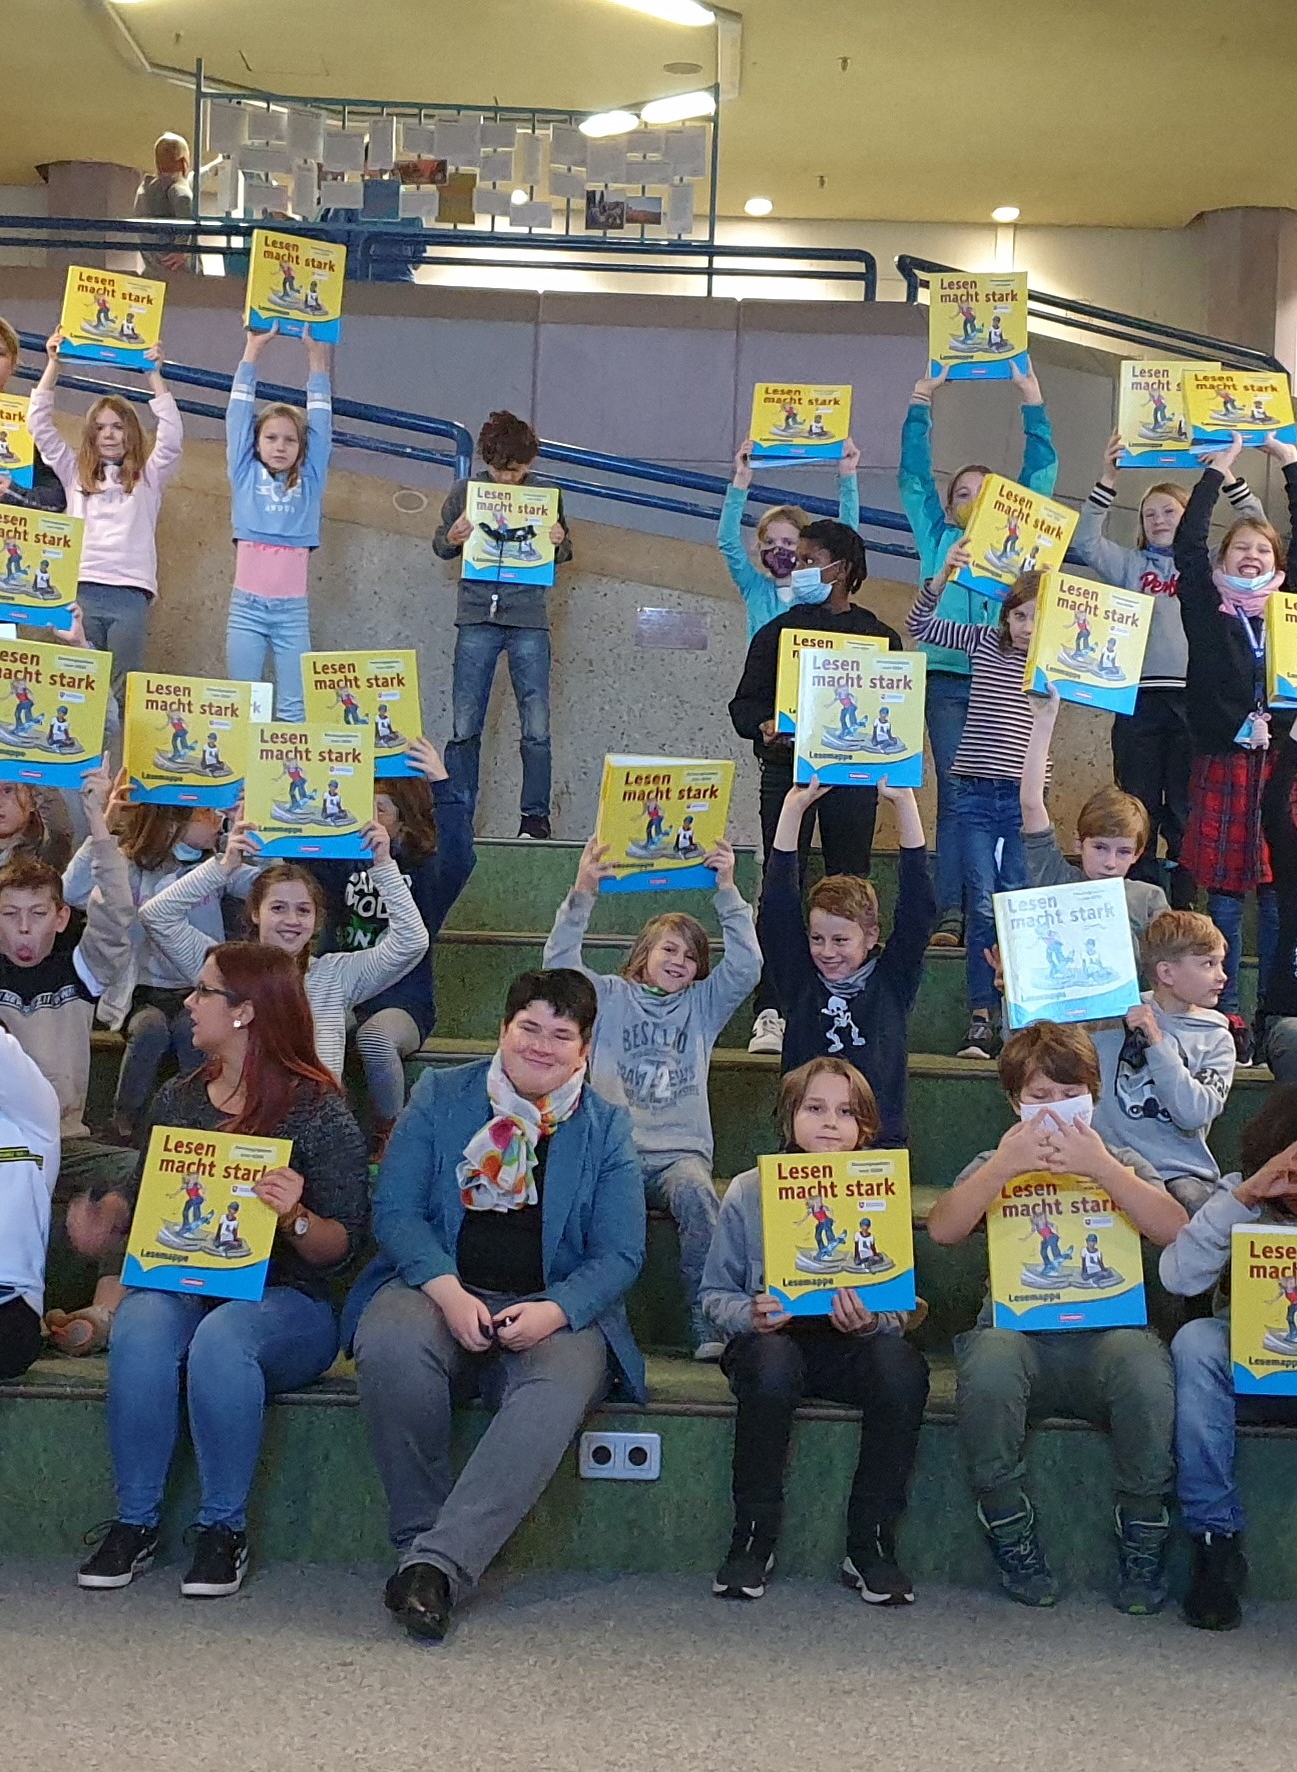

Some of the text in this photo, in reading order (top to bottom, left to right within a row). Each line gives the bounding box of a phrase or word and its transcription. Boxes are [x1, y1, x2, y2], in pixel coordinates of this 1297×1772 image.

[264, 237, 299, 252] Lesen
[263, 249, 335, 272] macht stark
[78, 272, 115, 287] Lesen
[940, 278, 977, 290] Lesen
[78, 283, 153, 305] macht stark
[940, 290, 1018, 303] macht stark
[1132, 366, 1169, 378] Lesen
[1195, 373, 1234, 382] Lesen
[764, 388, 801, 396] Lesen
[1131, 379, 1171, 392] macht
[1196, 382, 1278, 393] macht stark
[763, 396, 840, 406] macht stark
[477, 487, 511, 500] Lesen
[999, 485, 1033, 509] Lesen
[477, 501, 548, 516] macht stark
[994, 499, 1063, 540] macht stark
[34, 532, 71, 548] stark
[1058, 580, 1099, 601] Lesen
[1057, 597, 1139, 627] macht stark
[793, 635, 833, 648] Lesen
[313, 661, 356, 674] Lesen
[812, 656, 860, 672] Lesen
[49, 674, 95, 690] stark
[146, 681, 191, 697] Lesen
[314, 674, 405, 689] macht stark
[812, 673, 912, 690] macht stark
[146, 697, 193, 713] macht
[200, 702, 239, 717] stark
[260, 729, 308, 744] Lesen
[260, 747, 361, 763] macht stark
[624, 772, 671, 786] Lesen
[623, 785, 718, 801] macht stark
[1007, 895, 1057, 914] Lesen
[1070, 904, 1115, 920] stark
[638, 1064, 672, 1098] 72
[163, 1134, 216, 1156] Lesen
[159, 1157, 216, 1177] macht
[777, 1162, 833, 1180] Lesen
[778, 1178, 895, 1200] macht stark
[1001, 1183, 1057, 1198] Lesen
[1003, 1199, 1062, 1217] macht
[783, 1277, 834, 1287] Lesemappe
